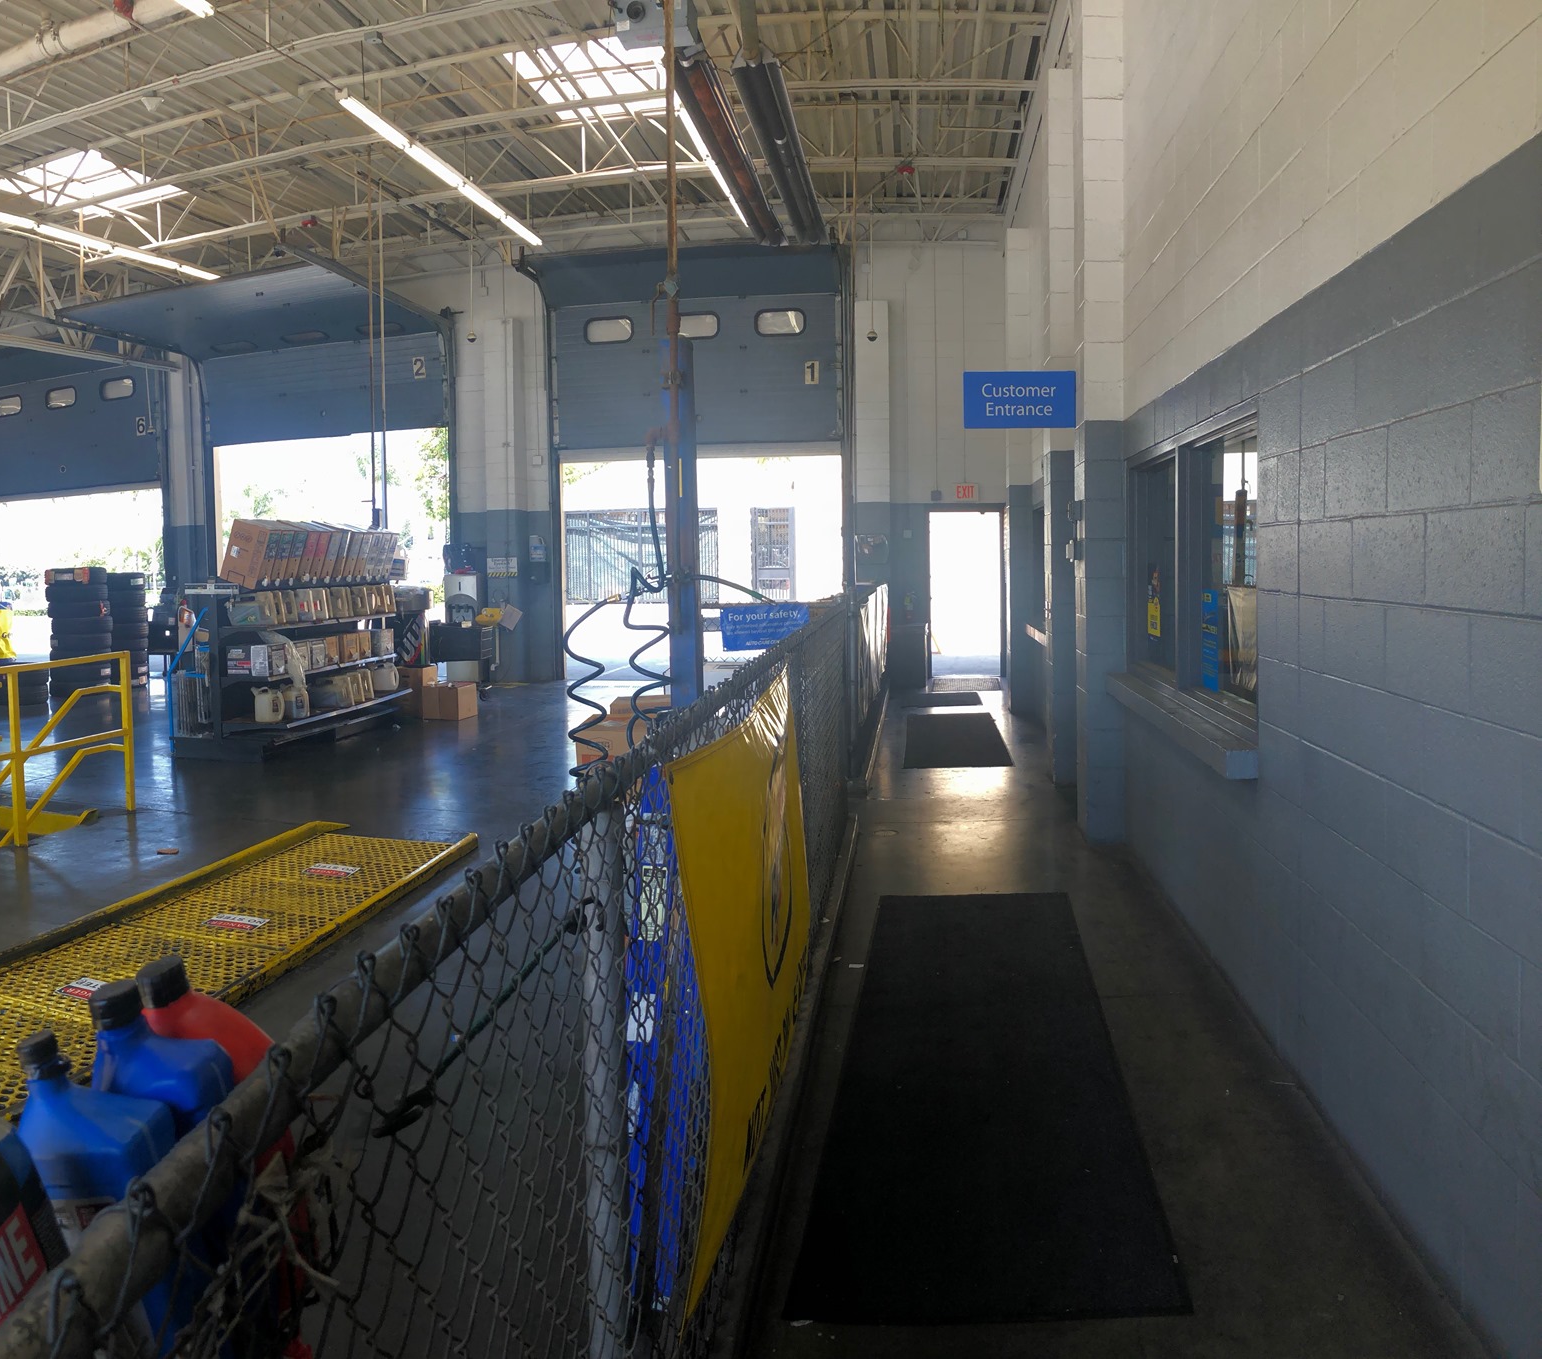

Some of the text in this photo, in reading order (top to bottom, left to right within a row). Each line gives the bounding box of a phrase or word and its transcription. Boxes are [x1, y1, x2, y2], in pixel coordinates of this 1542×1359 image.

[414, 358, 425, 376] 2
[806, 362, 815, 381] 1
[981, 383, 1057, 398] Customer
[985, 402, 1053, 416] Entrance
[137, 418, 146, 434] 6
[956, 485, 975, 499] EXIT
[728, 612, 743, 621] For
[745, 612, 767, 622] your
[211, 920, 252, 929] DANGER
[75, 979, 100, 989] TEP
[67, 988, 92, 997] NGER
